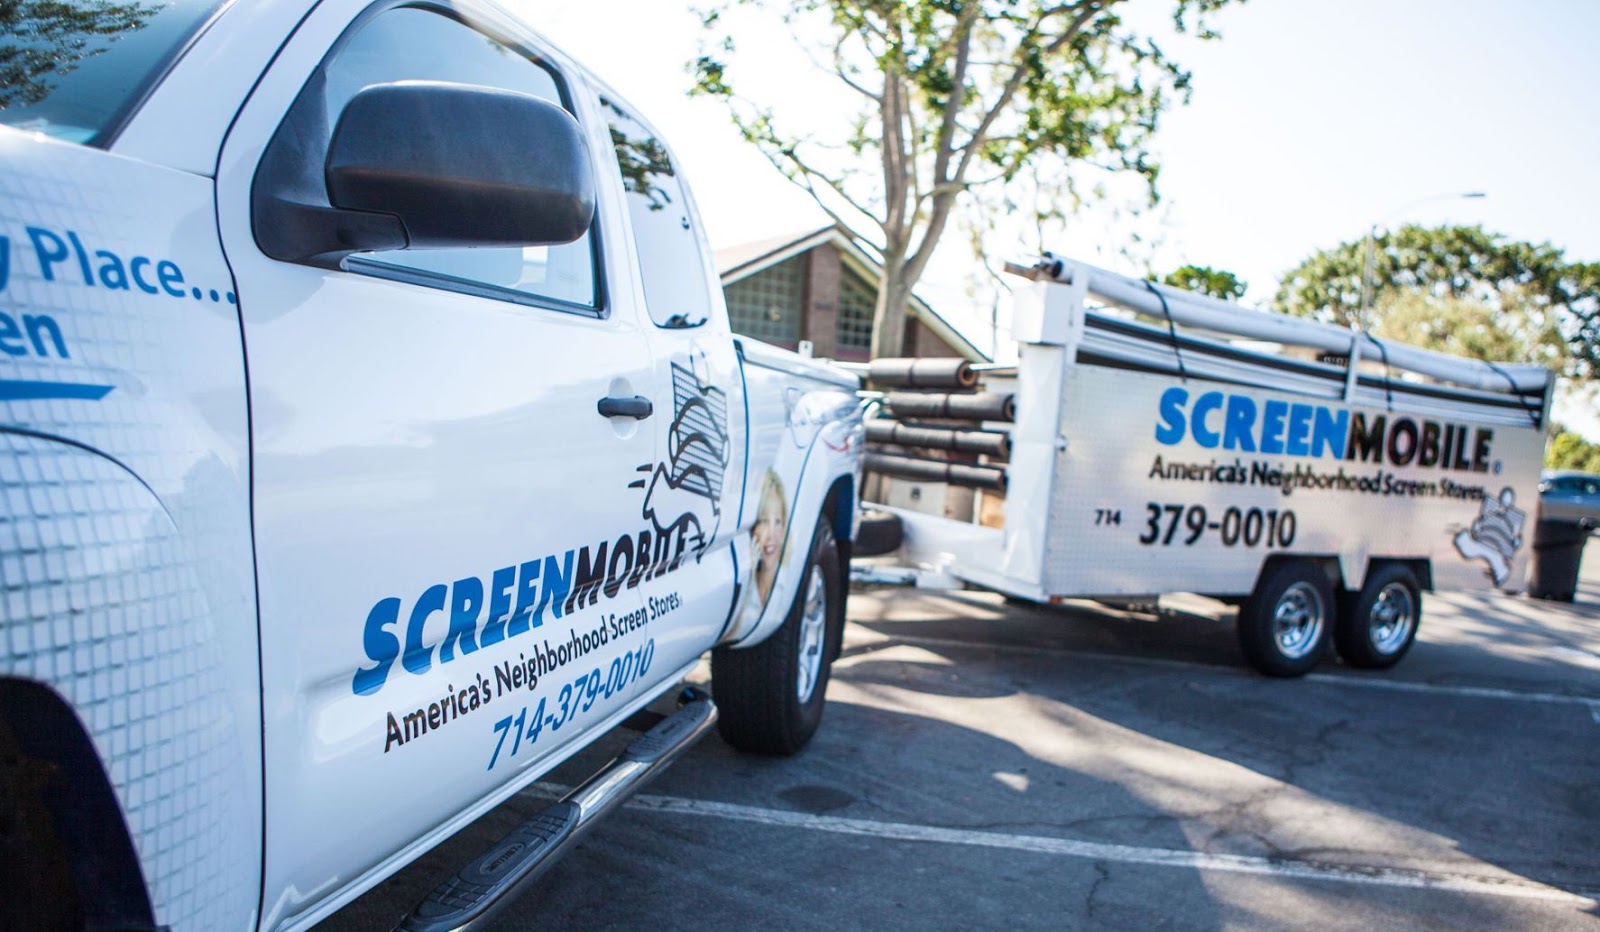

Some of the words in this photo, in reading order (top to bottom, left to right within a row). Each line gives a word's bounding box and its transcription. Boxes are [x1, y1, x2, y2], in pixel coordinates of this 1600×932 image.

[1149, 454, 1247, 485] America's
[1250, 461, 1381, 496] Neighborhood
[1381, 472, 1437, 496] Screen
[1155, 387, 1493, 473] SCREENMOBILE
[1094, 508, 1122, 526] 714
[1139, 501, 1297, 549] 379-0010
[352, 524, 690, 697] SCREENMOBILE
[384, 672, 493, 754] America's
[493, 614, 609, 698] Neighborhood
[609, 601, 649, 641] Screen
[648, 591, 681, 621] Stores
[487, 637, 656, 771] 714-379-0010
